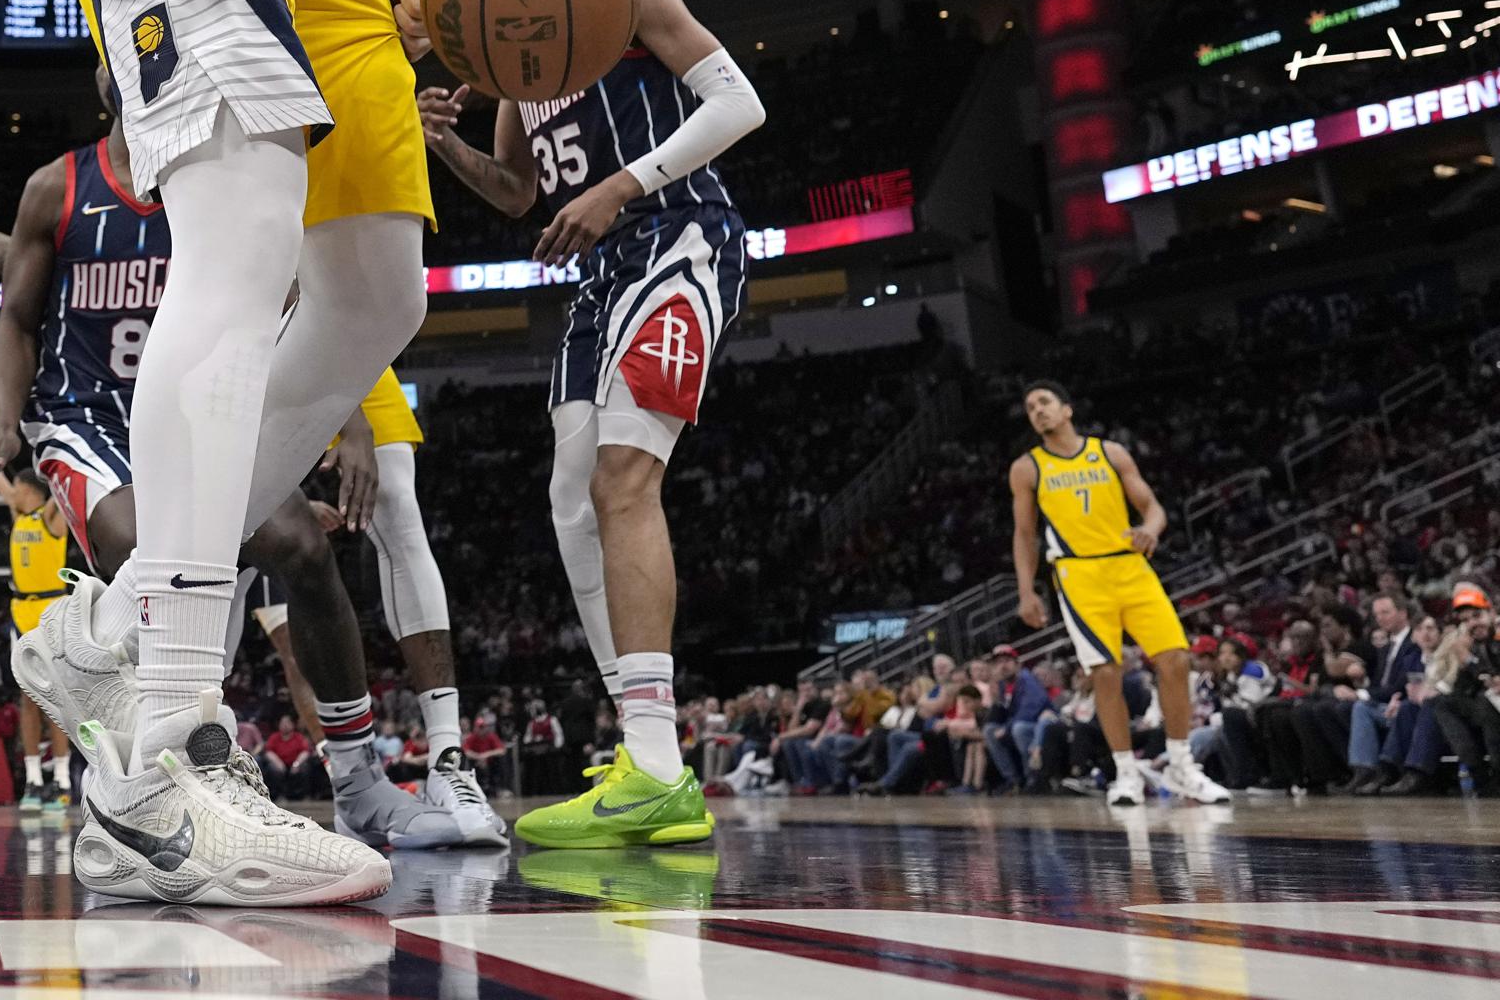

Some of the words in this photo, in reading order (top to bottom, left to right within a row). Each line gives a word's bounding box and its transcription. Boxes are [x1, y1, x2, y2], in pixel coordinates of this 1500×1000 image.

[532, 121, 589, 195] 35
[1146, 118, 1318, 186] DEFENSE
[71, 257, 172, 310] HOUST
[110, 318, 152, 379] 8
[1046, 467, 1111, 492] INDIANA
[1076, 489, 1090, 514] 7
